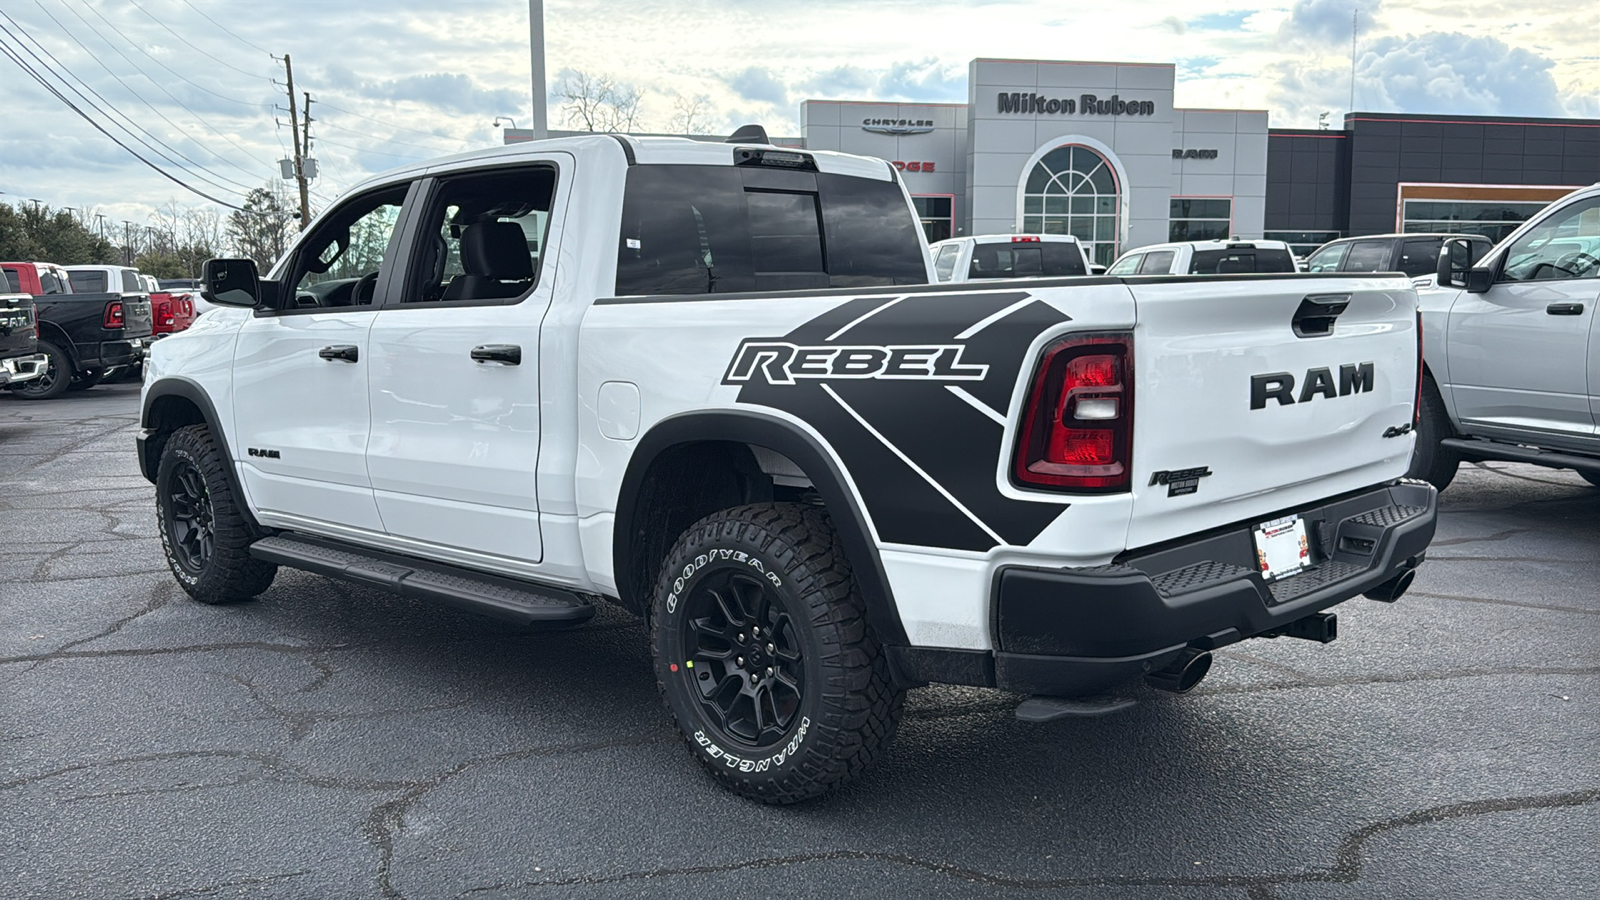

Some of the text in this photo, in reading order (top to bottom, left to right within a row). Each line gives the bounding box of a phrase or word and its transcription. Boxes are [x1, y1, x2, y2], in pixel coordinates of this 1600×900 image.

[997, 92, 1155, 116] Milton Ruben
[862, 118, 934, 127] CHRYSLER
[1172, 149, 1218, 160] RAM
[892, 161, 936, 173] DGE
[722, 341, 990, 385] REBEL
[1249, 361, 1375, 411] RAM
[248, 447, 281, 460] RAM
[1147, 466, 1213, 487] REBEL
[667, 549, 783, 613] GOODYEAR
[694, 716, 811, 772] WRANGLER
